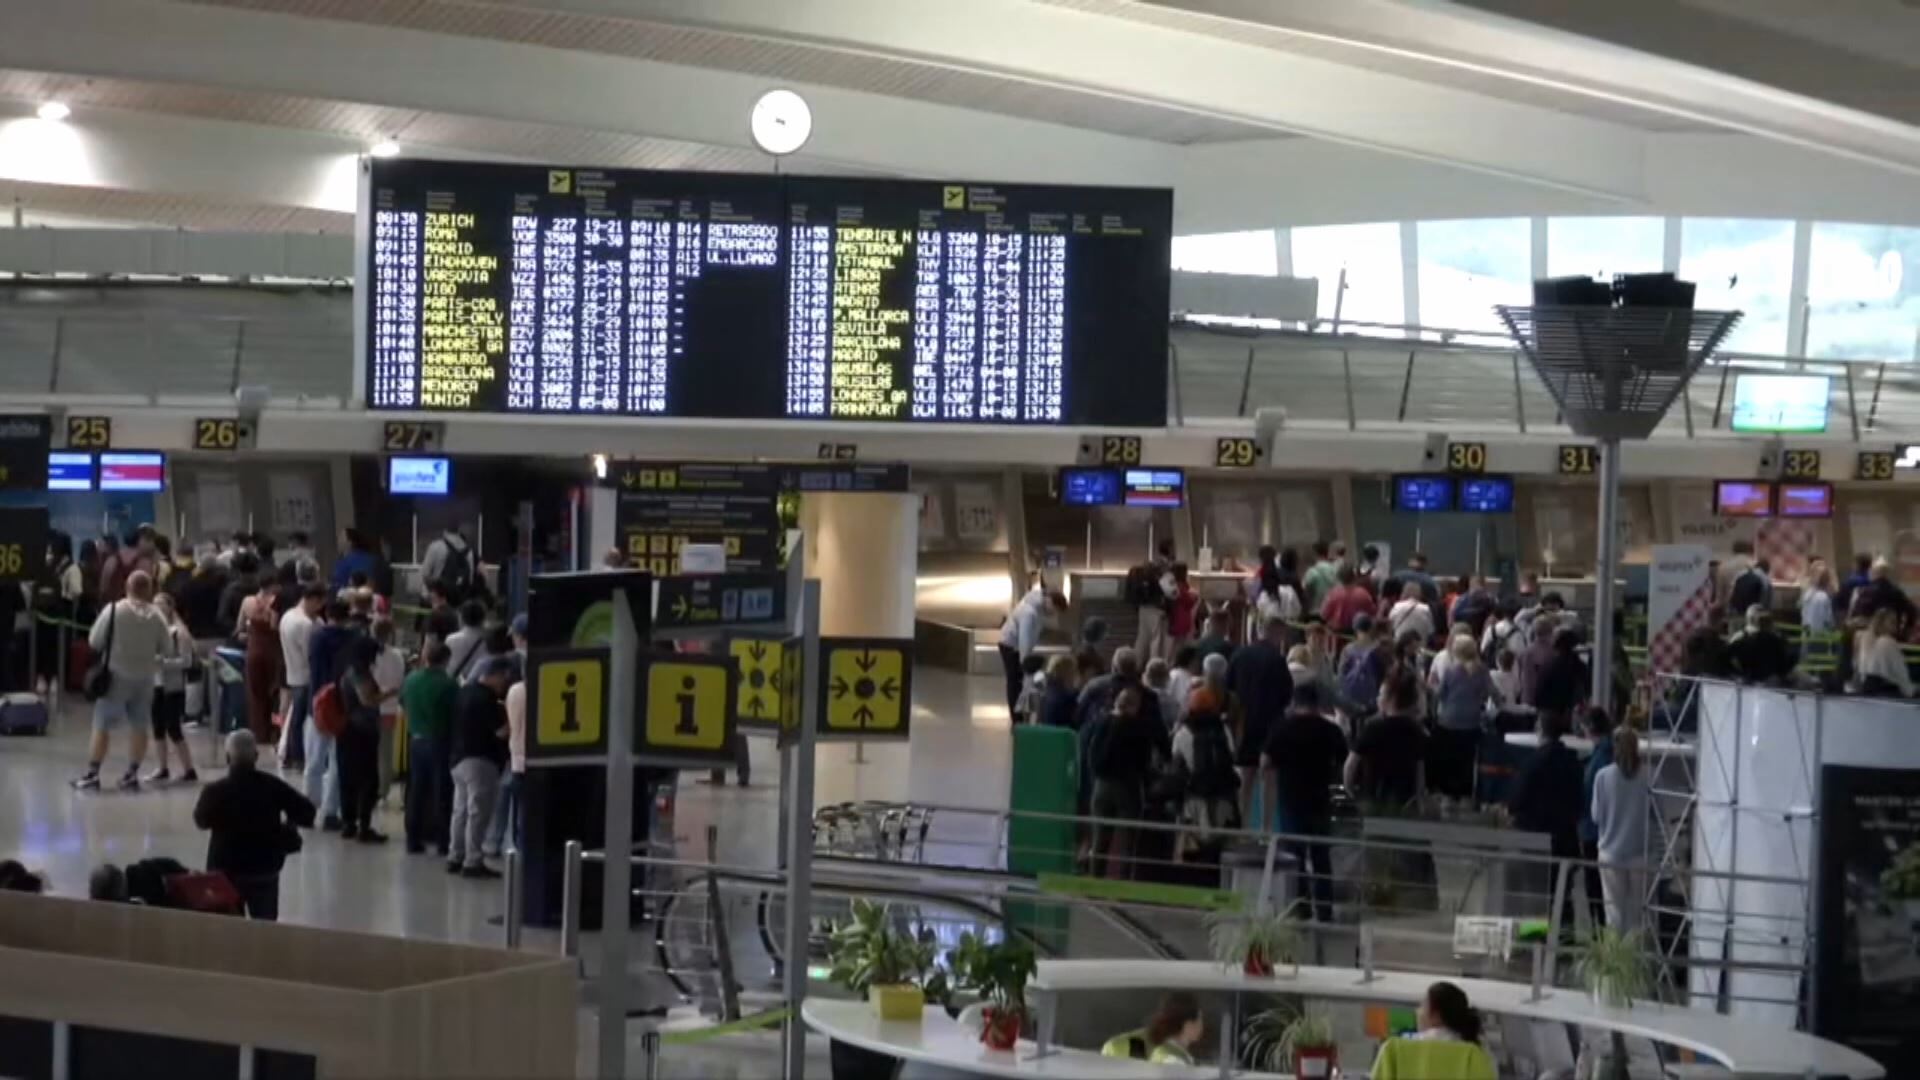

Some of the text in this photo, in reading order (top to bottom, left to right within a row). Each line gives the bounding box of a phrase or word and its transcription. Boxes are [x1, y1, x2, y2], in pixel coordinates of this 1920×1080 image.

[425, 213, 473, 227] ZURICH
[709, 224, 778, 238] RETRASADO
[425, 227, 457, 240] ROMA
[837, 227, 896, 241] TENERIFE
[424, 240, 472, 254] MADRID
[835, 240, 903, 255] AMSTERDAM
[424, 254, 496, 269] EINDHOVEN
[837, 254, 895, 268] ISTANBUL
[424, 268, 488, 282] VARSOVIA
[835, 267, 880, 281] LISBOA
[424, 282, 456, 295] VIGO
[834, 281, 879, 295] ATENAS
[424, 296, 495, 310] PARIS-CDG
[834, 294, 879, 308] MADRID
[423, 309, 502, 324] PARIS-ORLY
[833, 308, 909, 322] P.MALLORCA
[423, 323, 502, 338] MANCHESTER
[833, 321, 886, 335] SEVILLA
[423, 337, 479, 351] LONDRES
[833, 335, 900, 349] BARCELONA
[832, 349, 878, 362] MADRID
[422, 365, 494, 379] BARCELONA
[421, 379, 478, 392] MENORCA
[421, 392, 470, 406] MUNICH
[832, 389, 884, 402] LONDRES
[831, 403, 897, 416] FRANKFURT
[69, 419, 108, 447] 25
[200, 420, 234, 447] 26
[387, 423, 420, 449] 27
[1104, 438, 1138, 462] 28
[1220, 440, 1253, 464] 29
[1450, 445, 1483, 470] 30
[1562, 448, 1592, 473] 31
[1786, 452, 1817, 476] 32
[1861, 455, 1892, 478] 33
